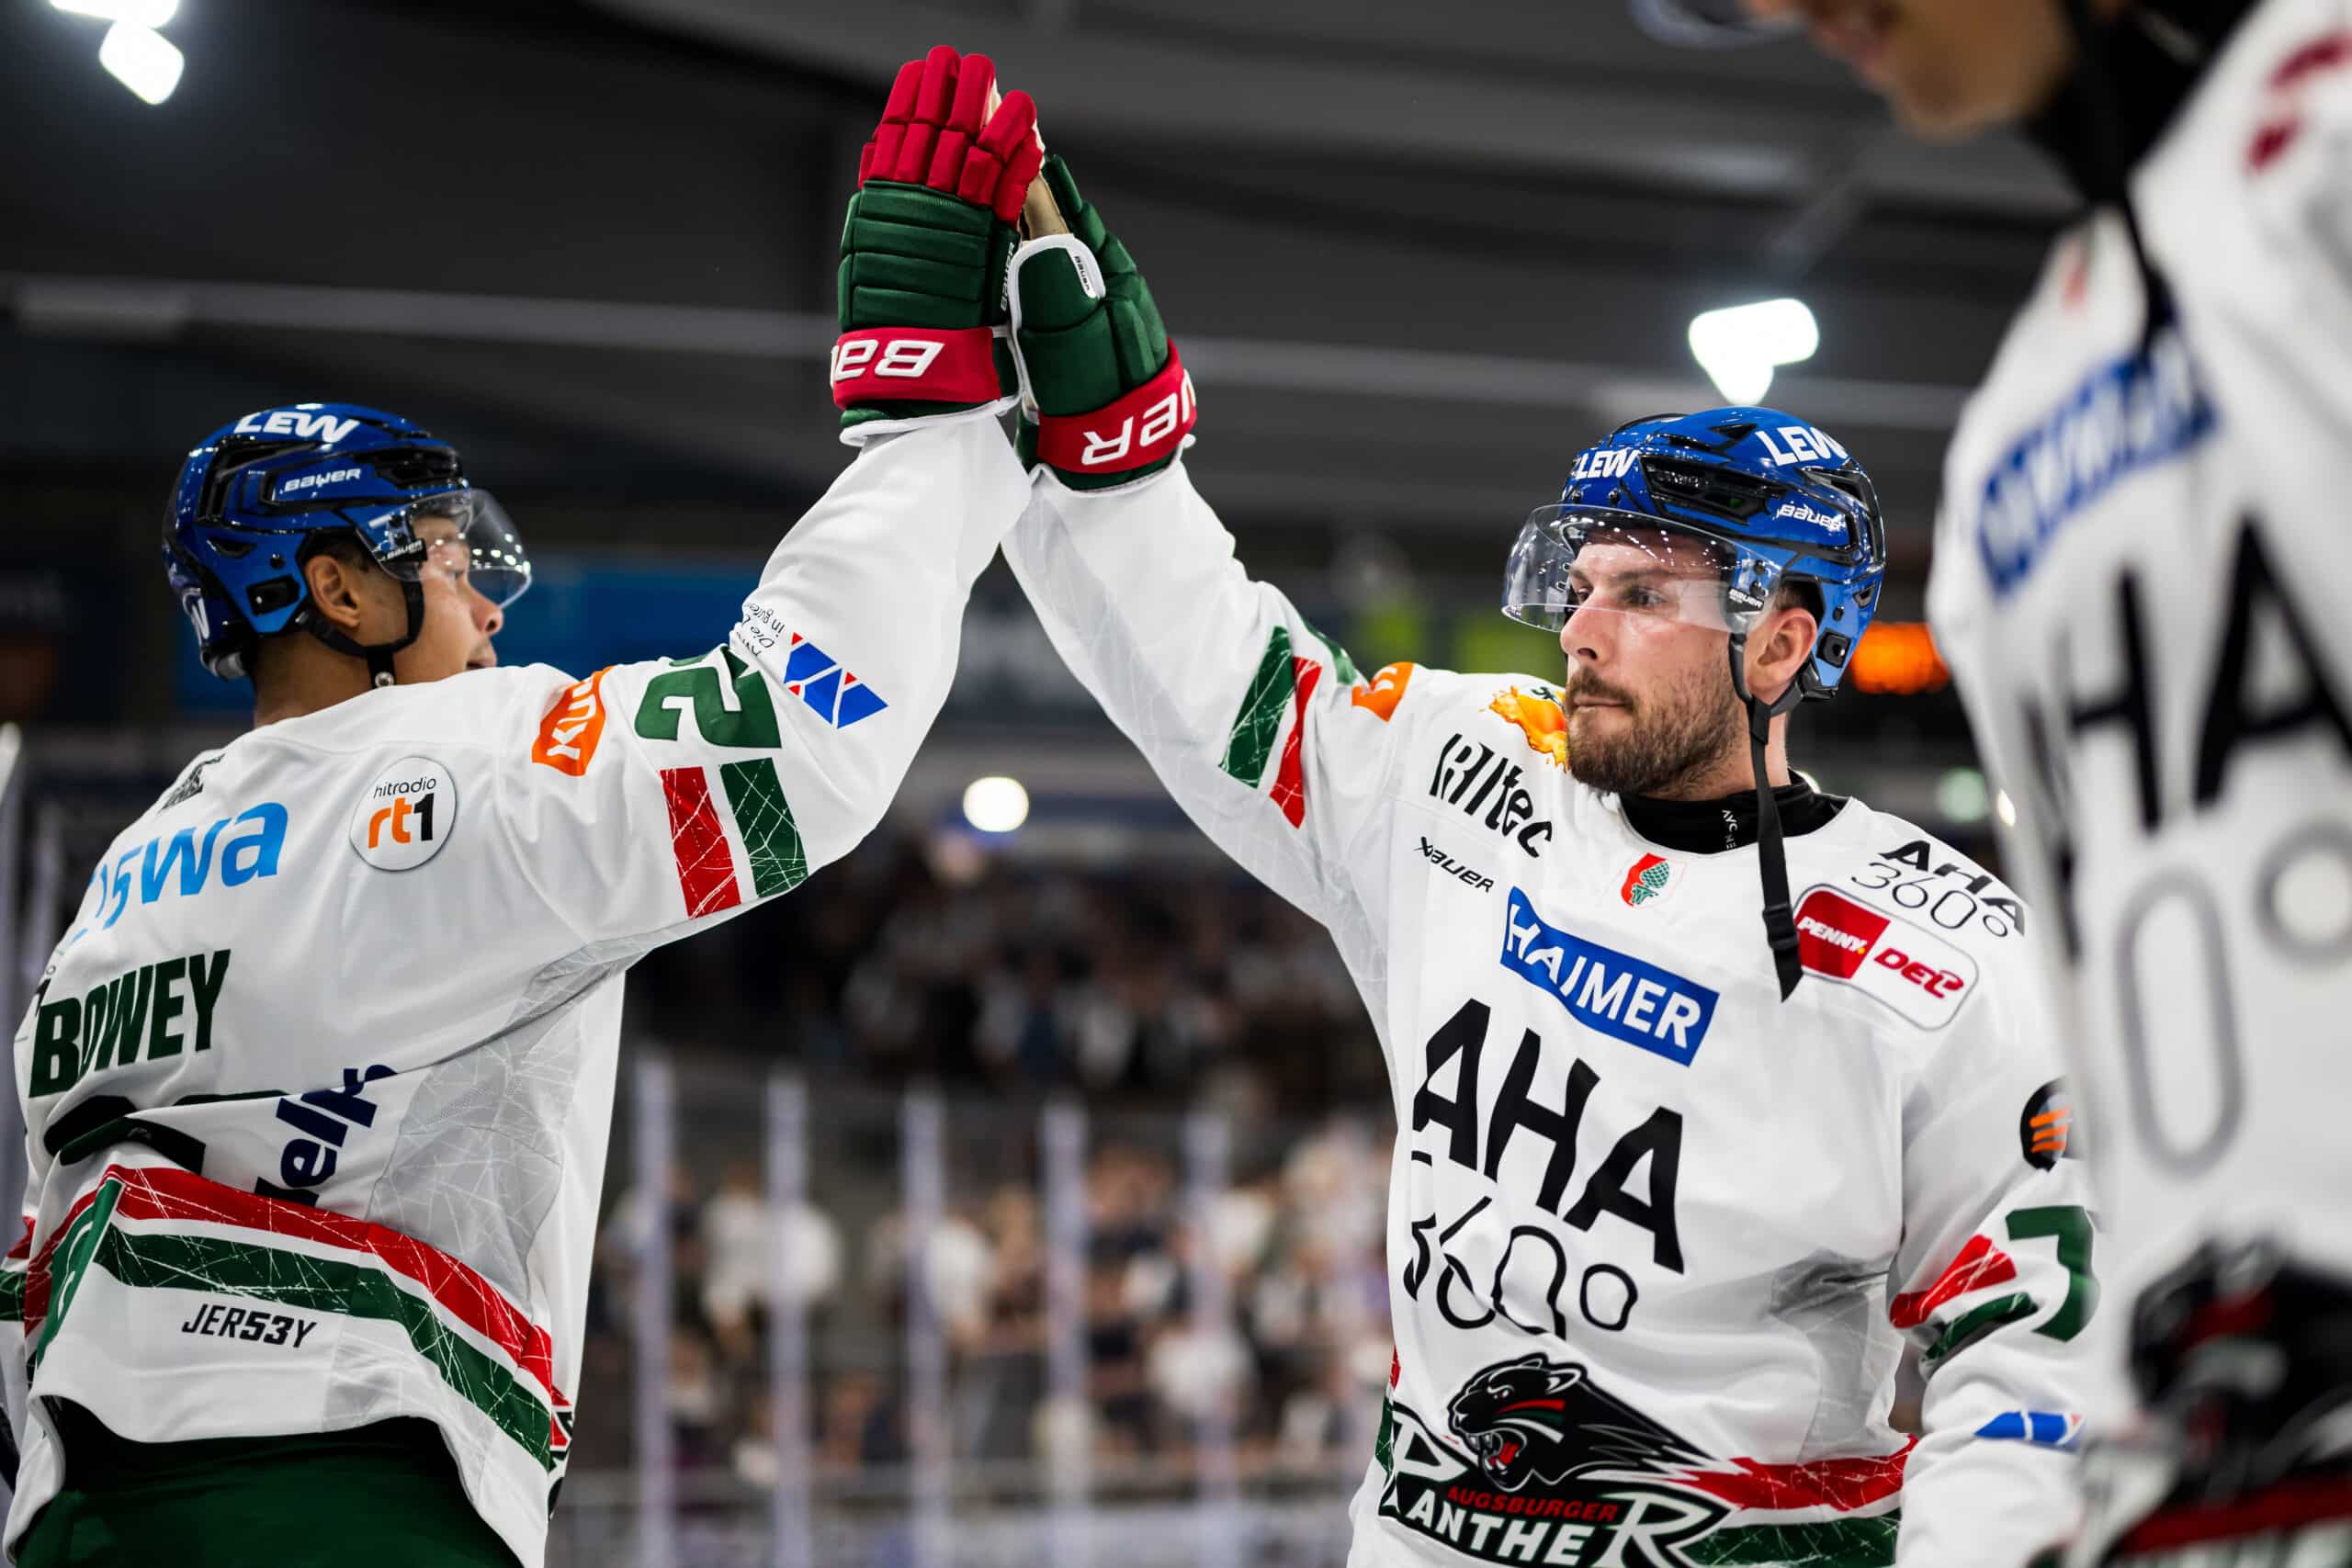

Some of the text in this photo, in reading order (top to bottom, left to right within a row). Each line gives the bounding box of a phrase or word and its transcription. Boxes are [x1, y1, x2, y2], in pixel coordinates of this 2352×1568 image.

[234, 411, 360, 443] LEW
[1755, 425, 1849, 467] LEW
[1573, 446, 1640, 479] LEW
[372, 776, 437, 800] hitradio
[368, 792, 435, 850] rt1
[1505, 903, 1702, 1049] HAIMER
[28, 948, 232, 1099] BOWEY
[1411, 997, 1686, 1276] AHA
[181, 1303, 318, 1348] JER53Y
[1447, 1484, 1621, 1524] AUGSBURGER
